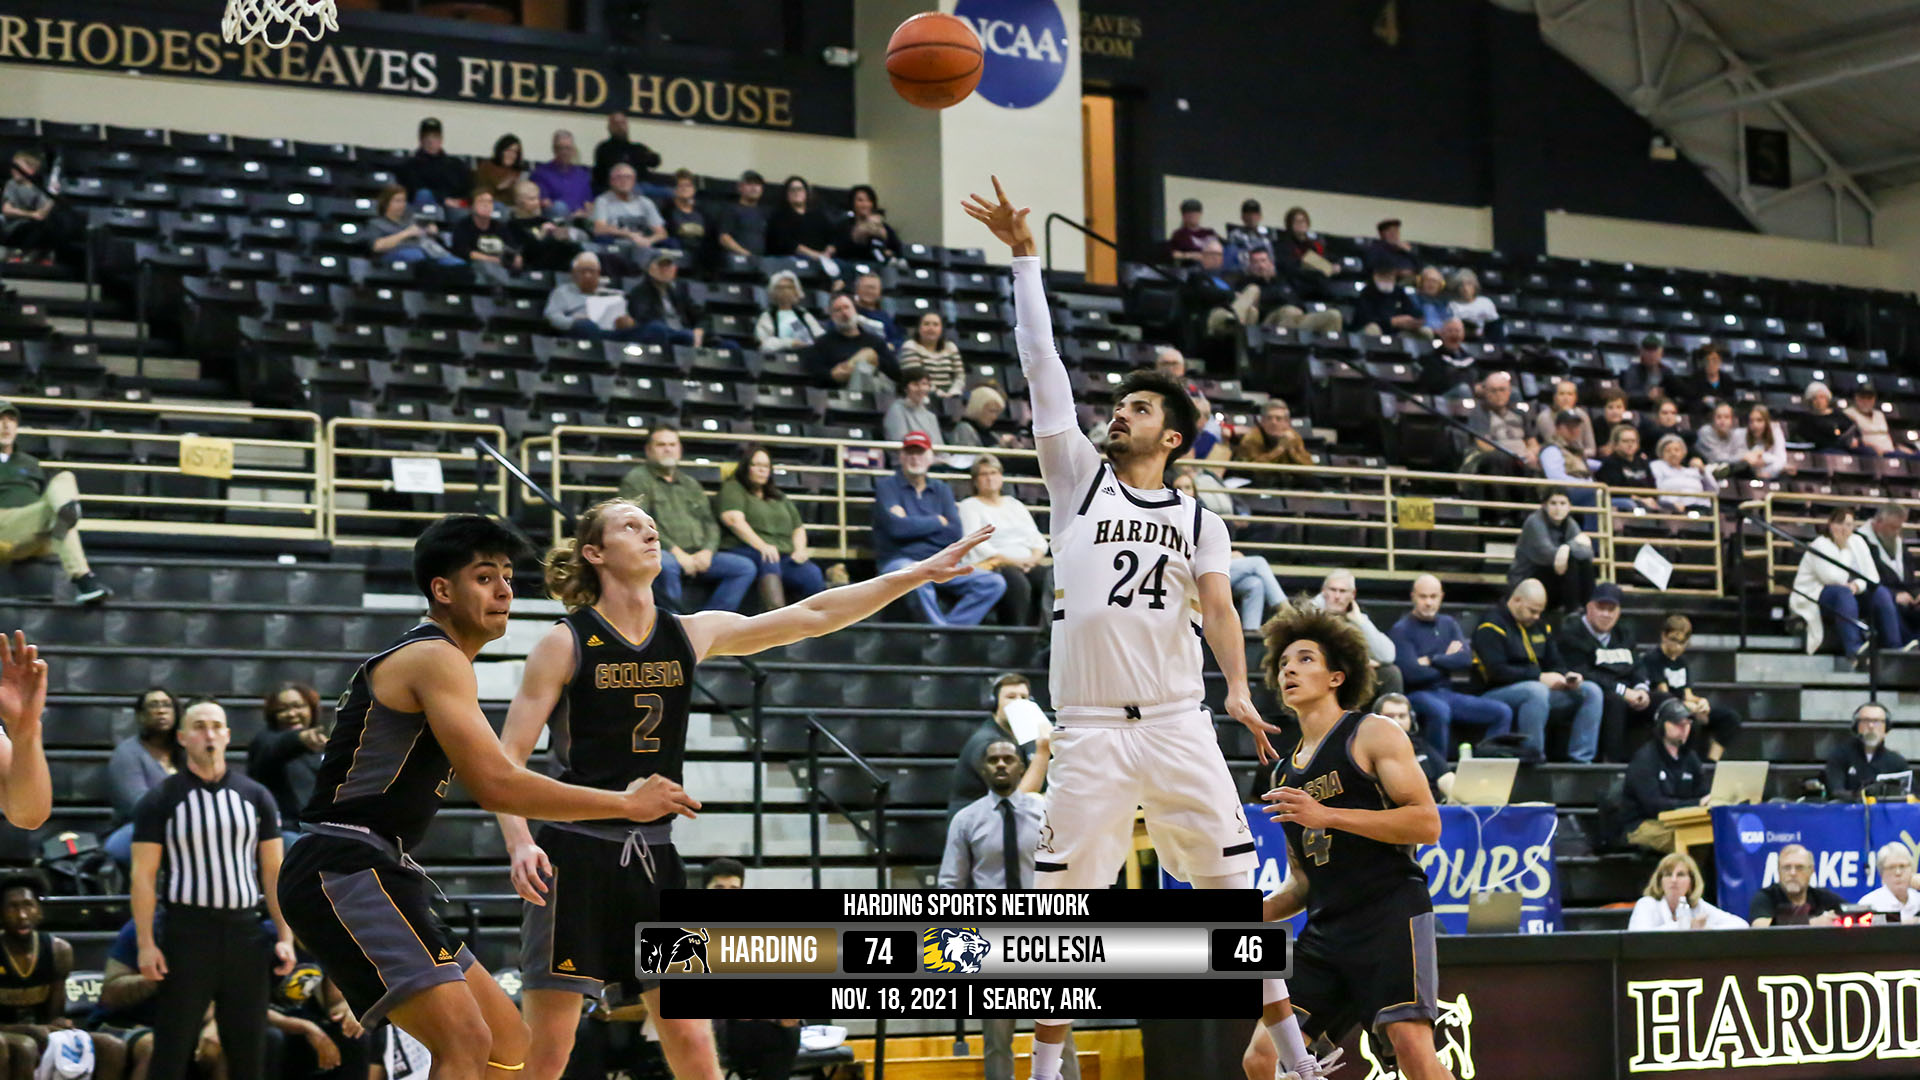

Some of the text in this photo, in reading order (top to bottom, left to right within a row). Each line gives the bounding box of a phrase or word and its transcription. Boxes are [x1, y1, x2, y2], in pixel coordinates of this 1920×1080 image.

[0, 14, 793, 127] RHODES-REAVES FIELD HOUSE
[1107, 550, 1169, 610] 24
[595, 660, 684, 689] ECCLESIA
[632, 693, 664, 753] 2
[1417, 844, 1551, 899] OURS
